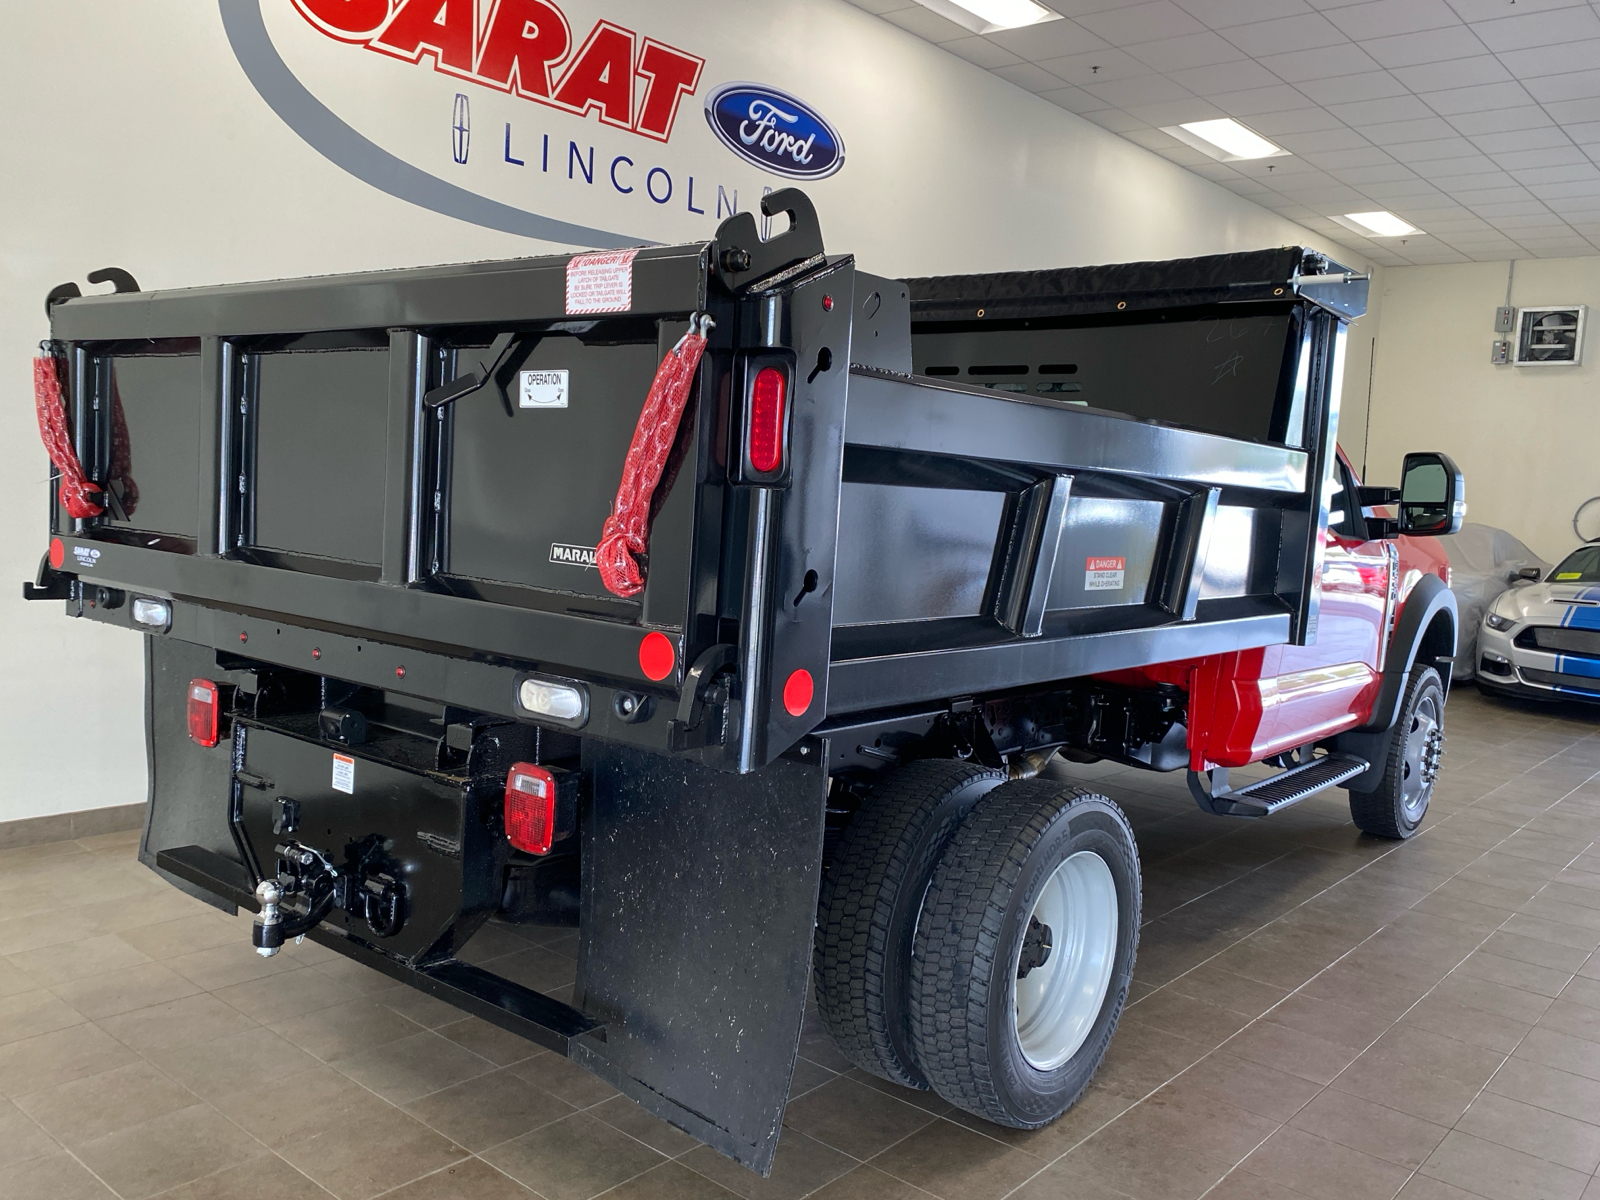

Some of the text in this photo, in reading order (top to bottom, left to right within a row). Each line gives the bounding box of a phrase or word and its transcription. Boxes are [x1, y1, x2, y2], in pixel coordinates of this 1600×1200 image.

[739, 99, 816, 164] Ford
[504, 122, 738, 219] LINCOLN
[588, 268, 612, 276] RELEASING
[528, 373, 562, 385] OPERATION
[553, 547, 598, 563] MARAU
[1096, 560, 1117, 568] DANGER
